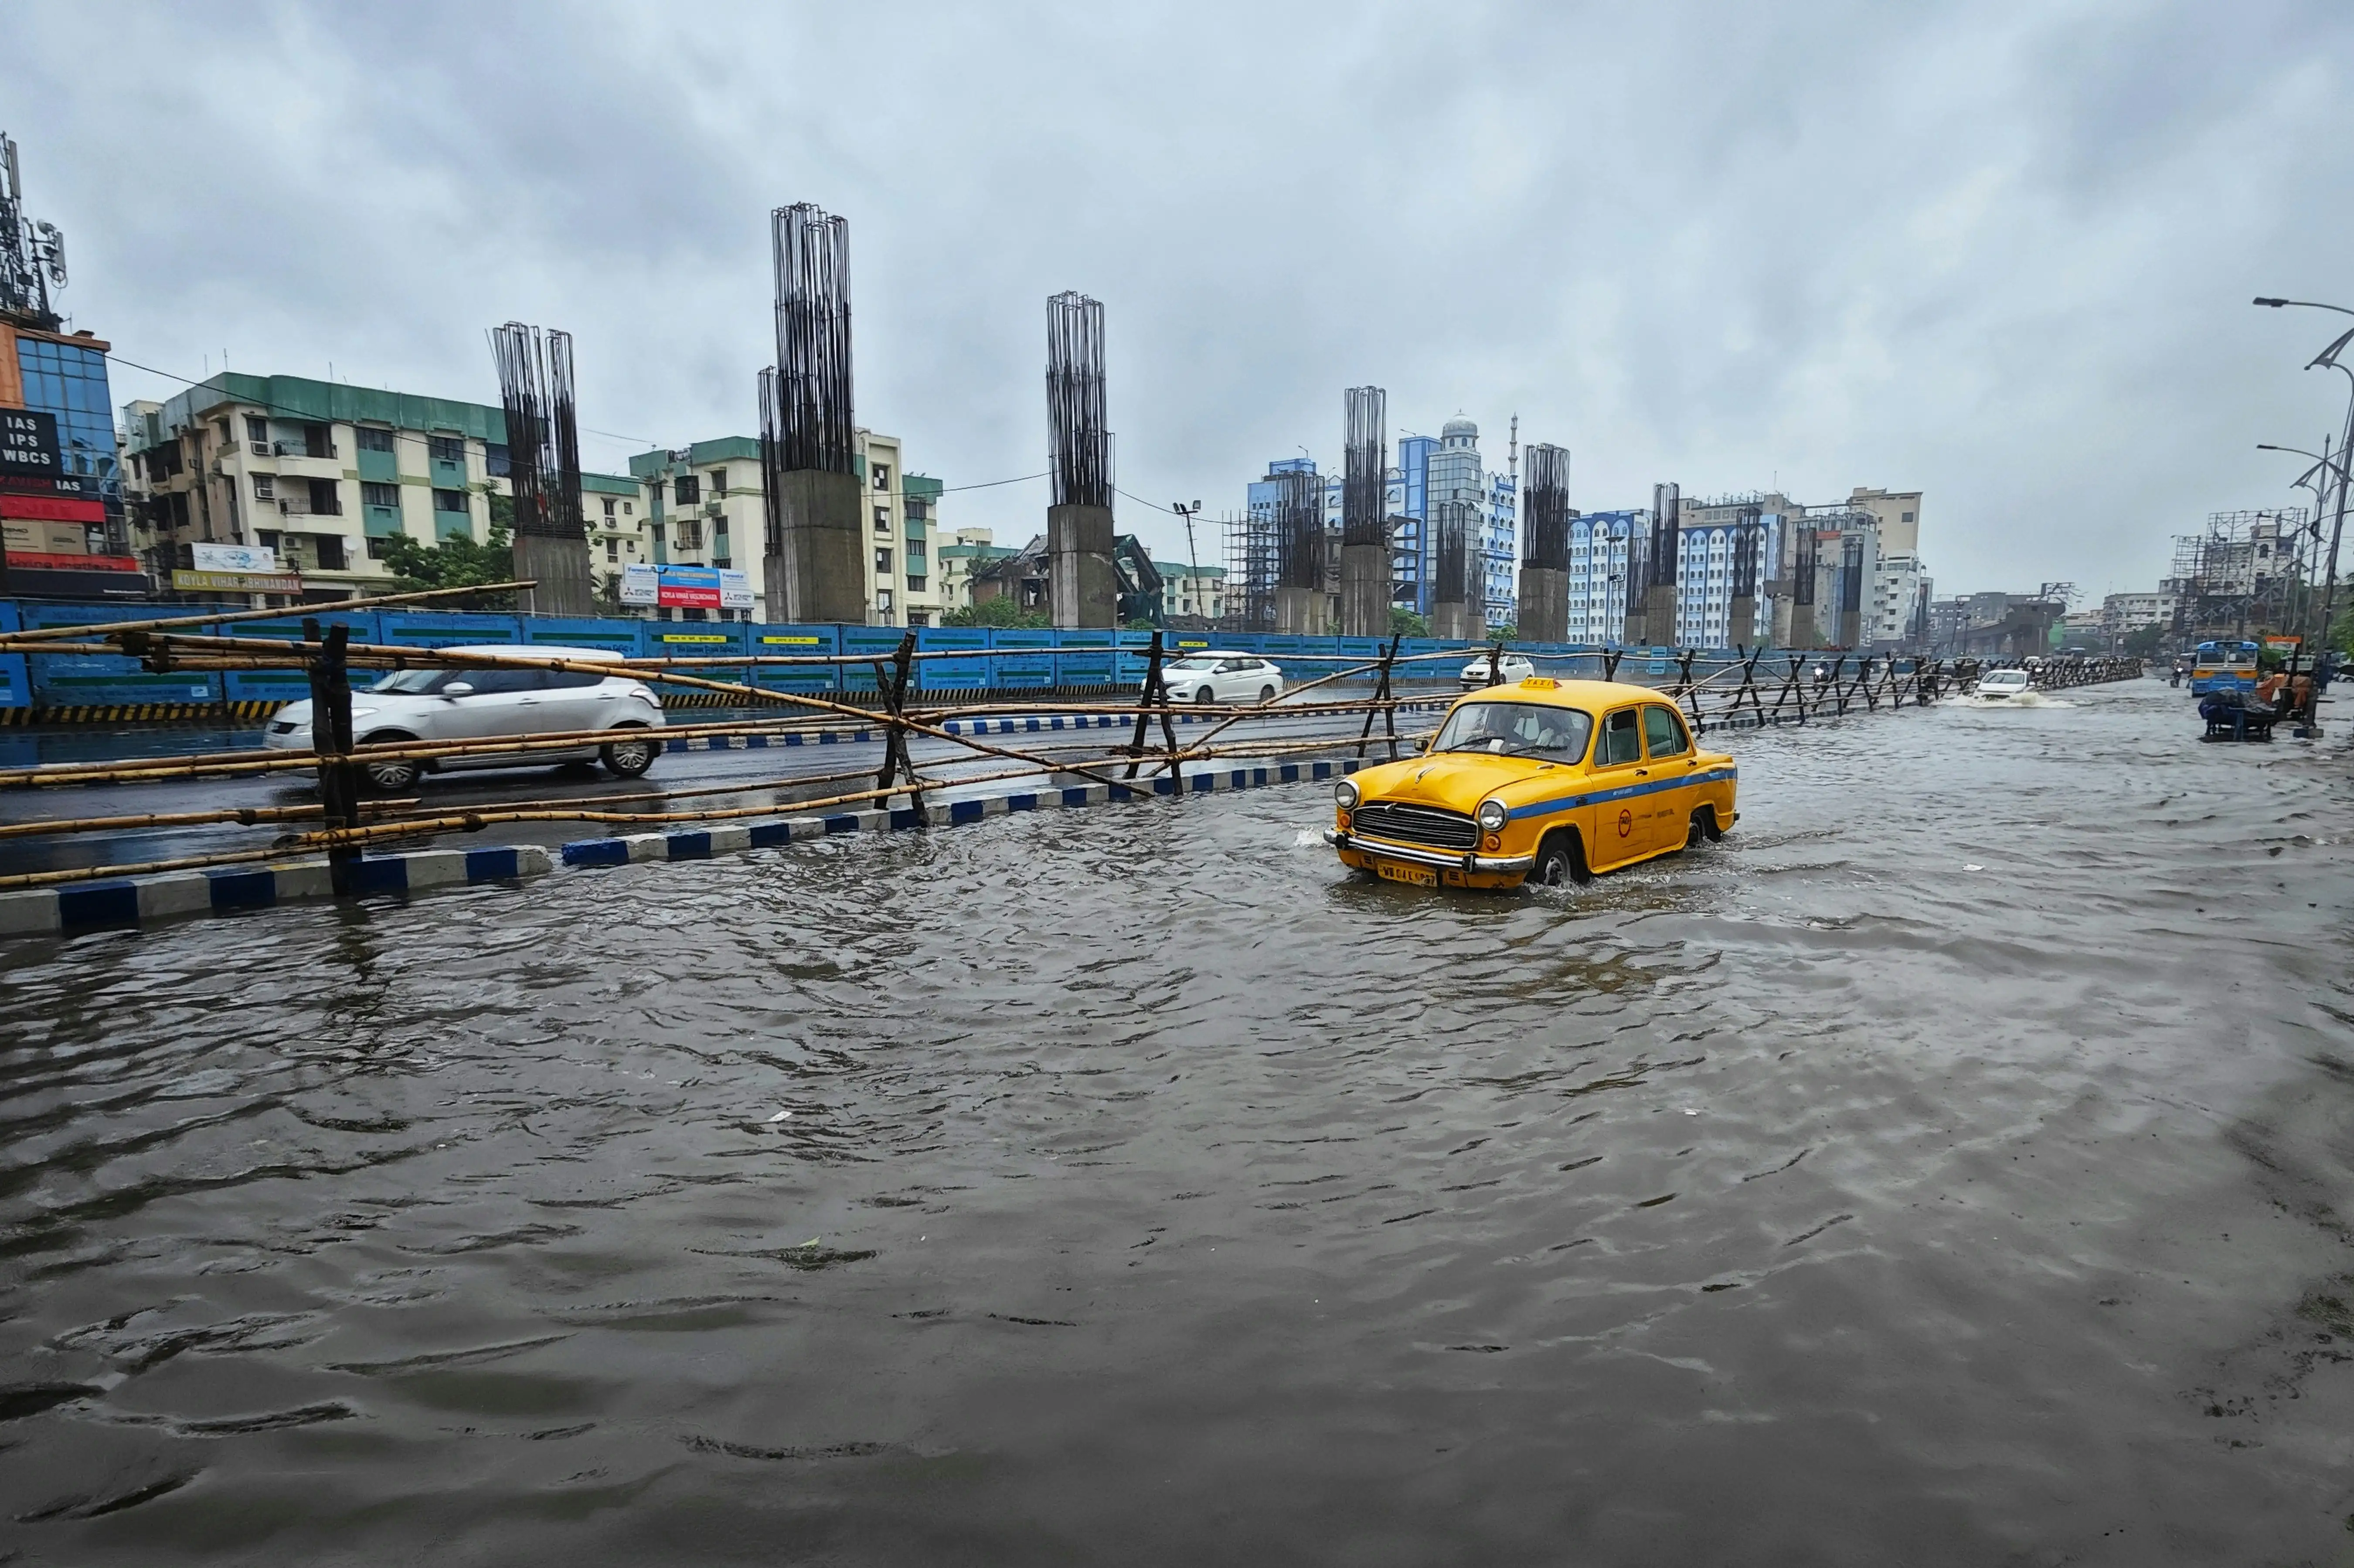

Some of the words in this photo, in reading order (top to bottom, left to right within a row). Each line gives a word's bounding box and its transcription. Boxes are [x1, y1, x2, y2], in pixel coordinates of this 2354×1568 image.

[6, 416, 37, 431] IAS
[9, 433, 38, 447] IPS
[2, 449, 51, 465] WBCS
[56, 480, 81, 491] IAS
[177, 573, 209, 587] KOYLA
[211, 575, 240, 588] VIHAR
[242, 577, 299, 591] ABHINANDAN
